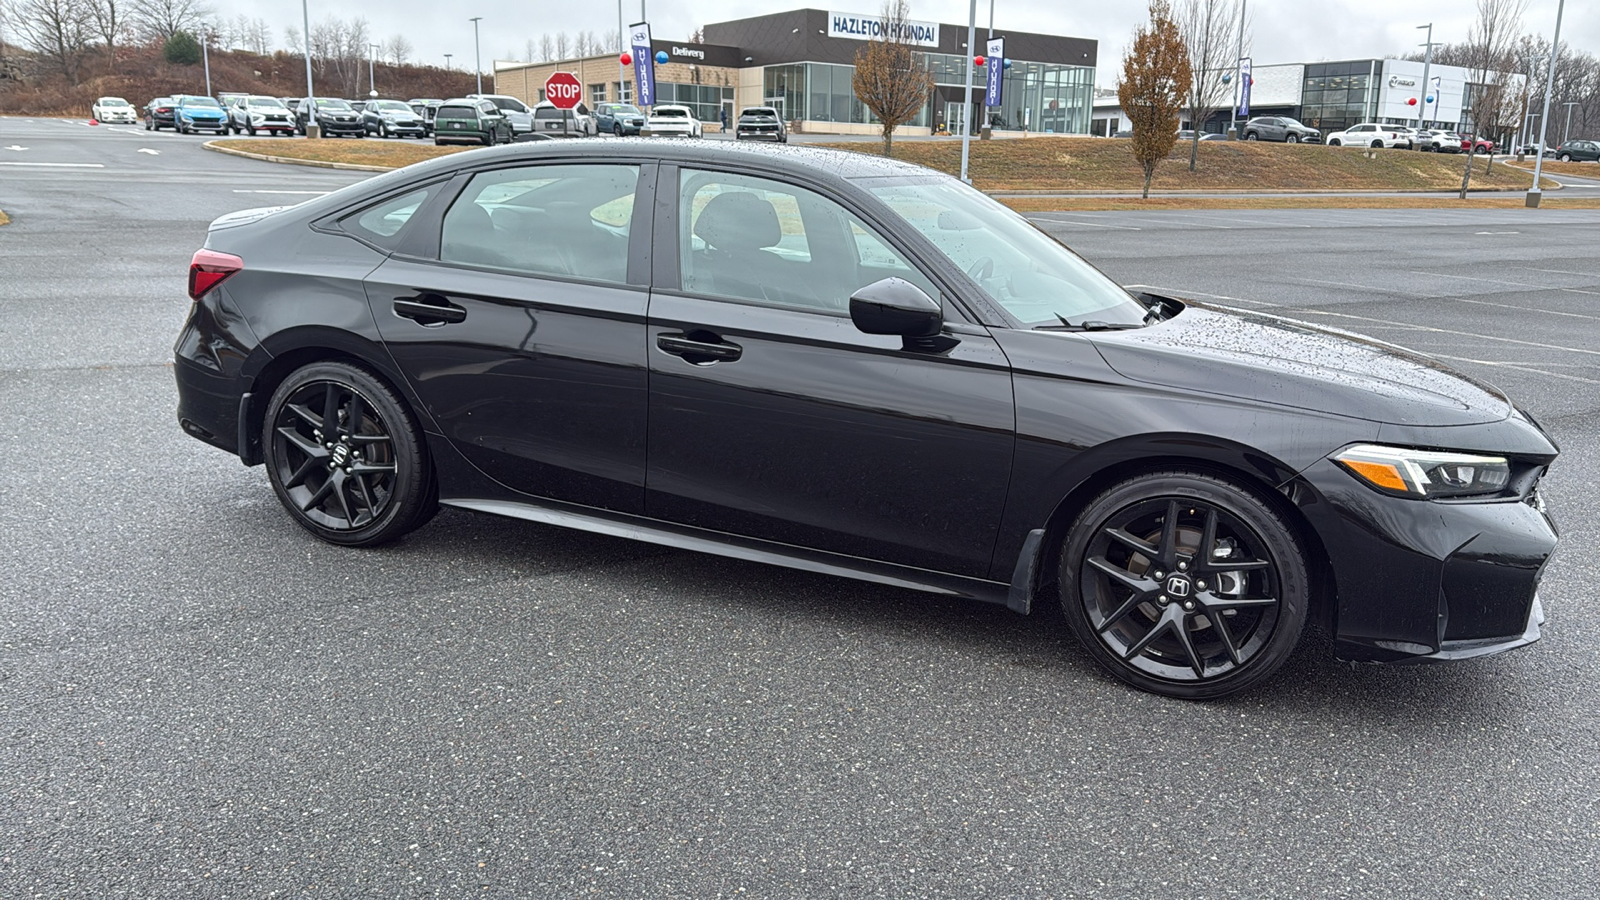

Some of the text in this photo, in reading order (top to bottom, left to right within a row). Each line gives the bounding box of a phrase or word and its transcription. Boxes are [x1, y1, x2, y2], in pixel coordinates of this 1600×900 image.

[833, 16, 935, 42] HAZLETON HYUNDAI
[672, 46, 705, 60] Delivery
[638, 48, 649, 104] HYUNDAI
[990, 58, 998, 105] HYUNDAI
[548, 83, 580, 98] STOP
